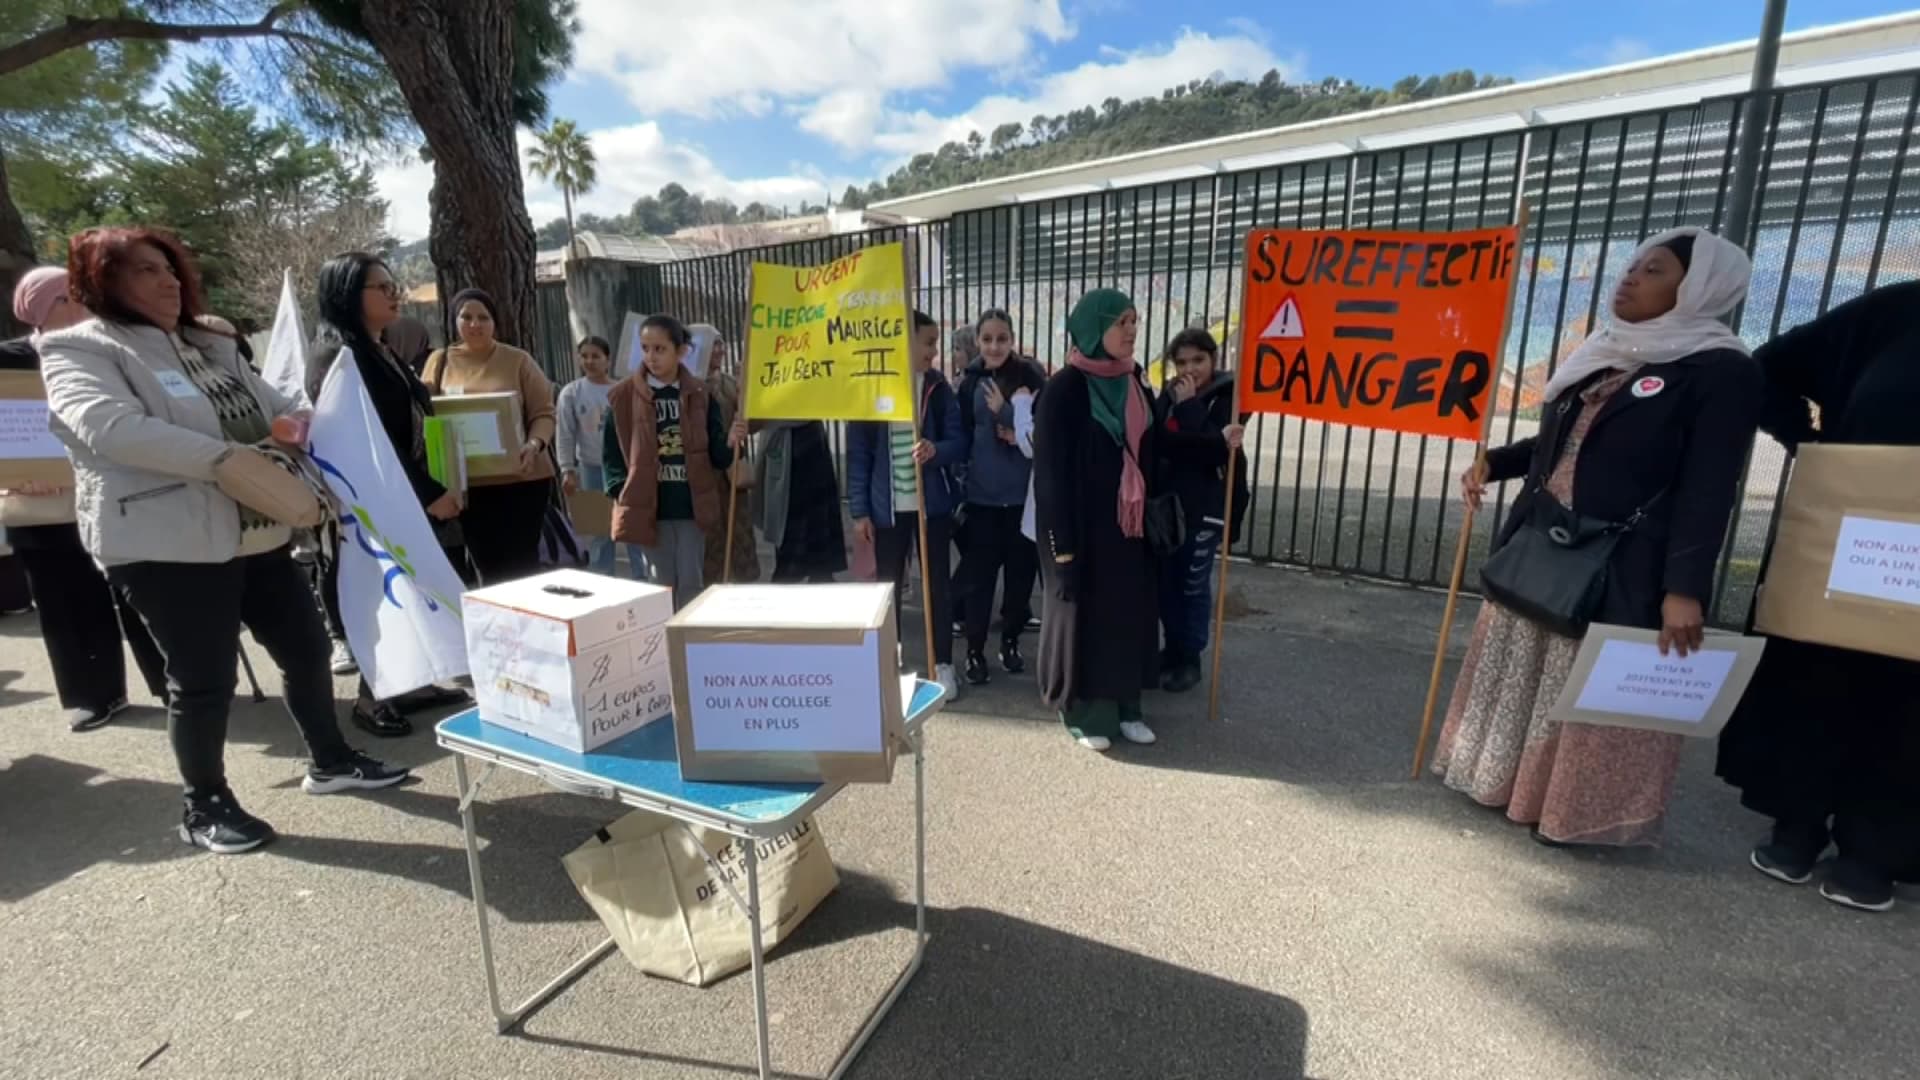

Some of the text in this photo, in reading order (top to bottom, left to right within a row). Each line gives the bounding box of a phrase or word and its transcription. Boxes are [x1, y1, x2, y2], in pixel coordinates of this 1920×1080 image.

[795, 252, 862, 293] URGENT
[752, 303, 826, 329] CHERCHE
[774, 332, 810, 354] POUR
[760, 348, 900, 387] JAUBERT II
[1253, 343, 1490, 422] DANGER
[1853, 539, 1920, 553] NON AUX
[1849, 554, 1915, 571] OUI A UN
[1883, 576, 1902, 587] EN
[704, 674, 833, 687] NON AUX ALGECOS
[705, 696, 832, 709] OUI A UN COLLEGE
[591, 709, 632, 736] POUR
[744, 718, 800, 730] EN PLUS
[696, 880, 718, 901] DE
